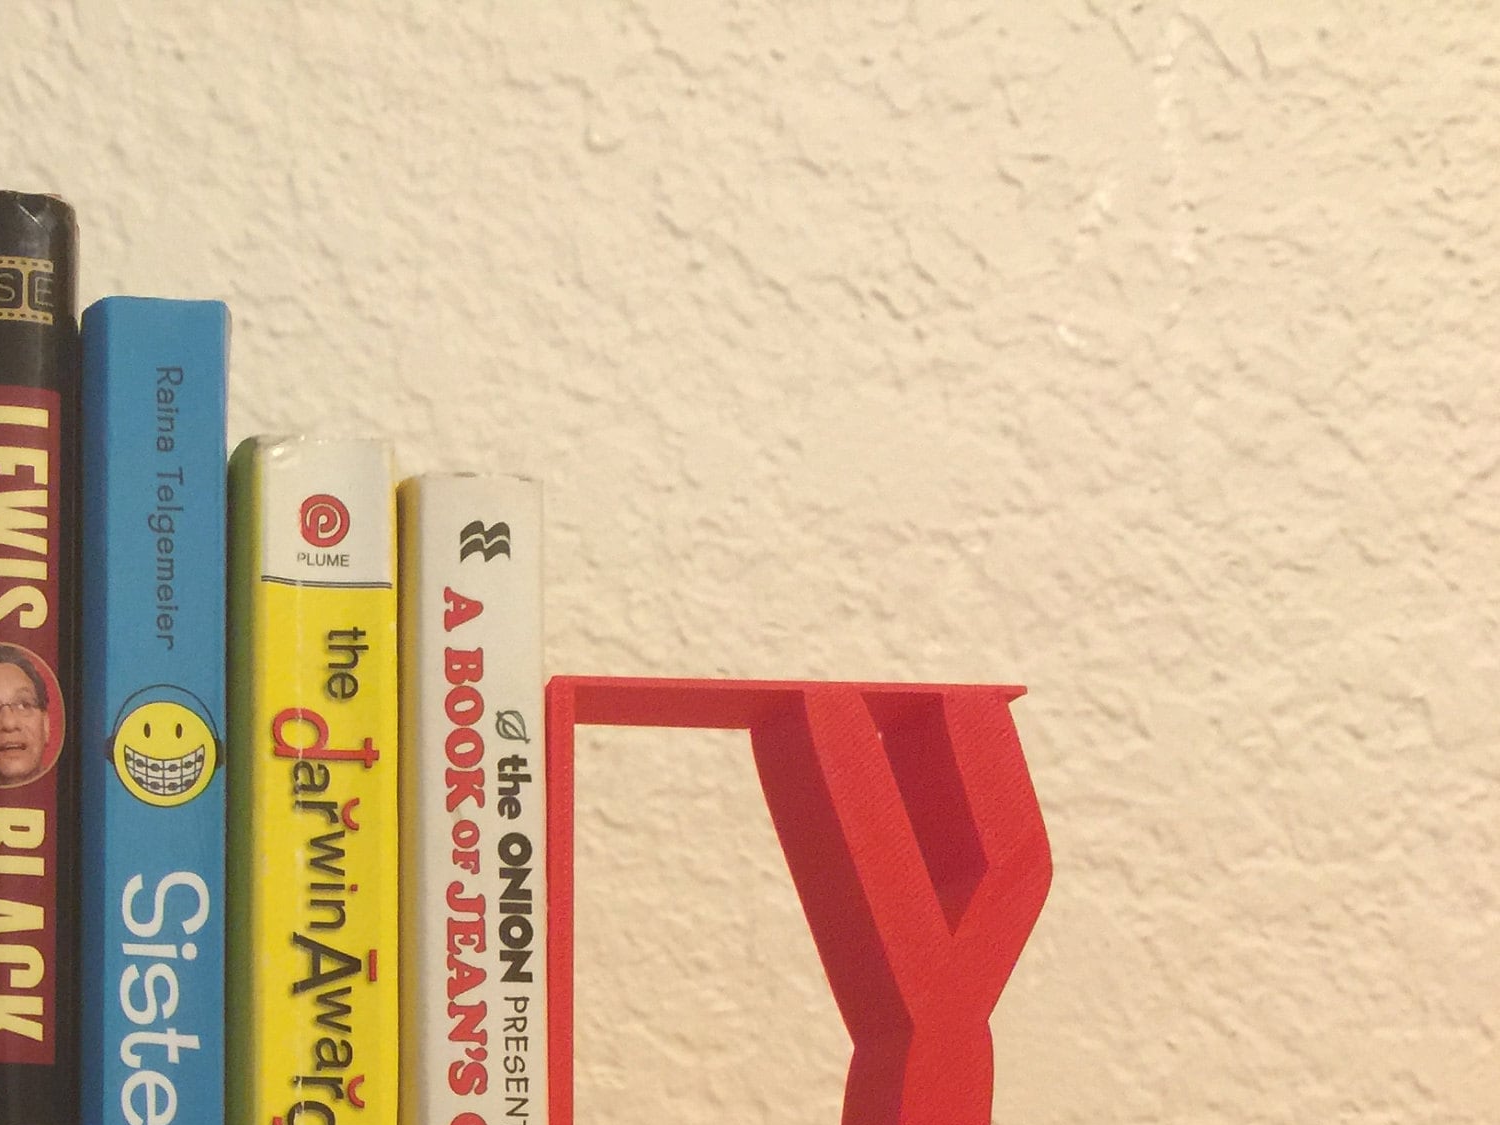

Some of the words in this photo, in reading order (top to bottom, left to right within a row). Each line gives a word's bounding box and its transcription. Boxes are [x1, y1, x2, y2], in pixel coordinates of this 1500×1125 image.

[155, 366, 183, 453] Raina
[147, 466, 183, 651] Telgemeier
[297, 552, 350, 568] PLUME
[443, 586, 484, 632] A
[327, 626, 368, 699] the
[444, 647, 485, 812] BOOK
[497, 754, 532, 820] the
[451, 819, 480, 875] OF
[497, 832, 533, 983] ONION
[446, 880, 488, 1096] JEAN'S
